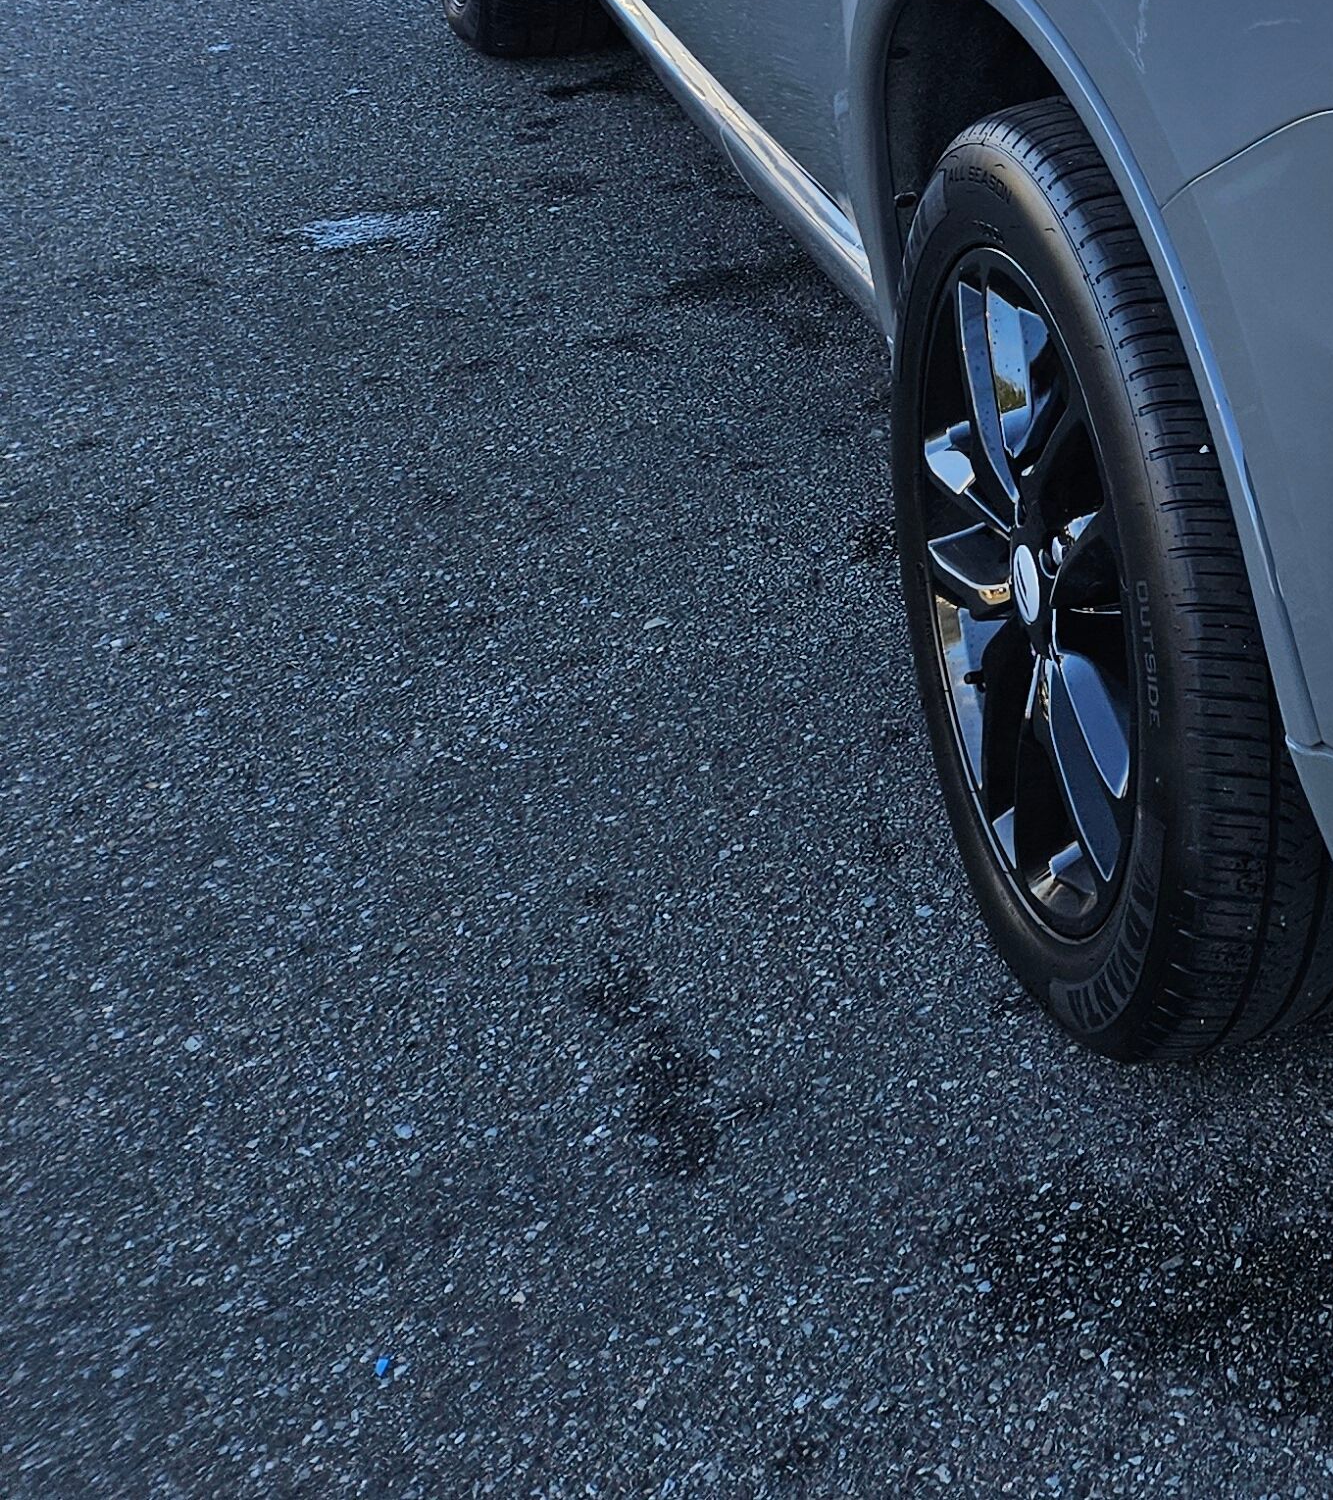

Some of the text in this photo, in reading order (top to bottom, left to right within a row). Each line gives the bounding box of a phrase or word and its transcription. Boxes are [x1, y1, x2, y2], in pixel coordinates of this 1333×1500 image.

[948, 166, 1013, 205] ALL SEASON
[1135, 580, 1161, 729] OUTSIDE
